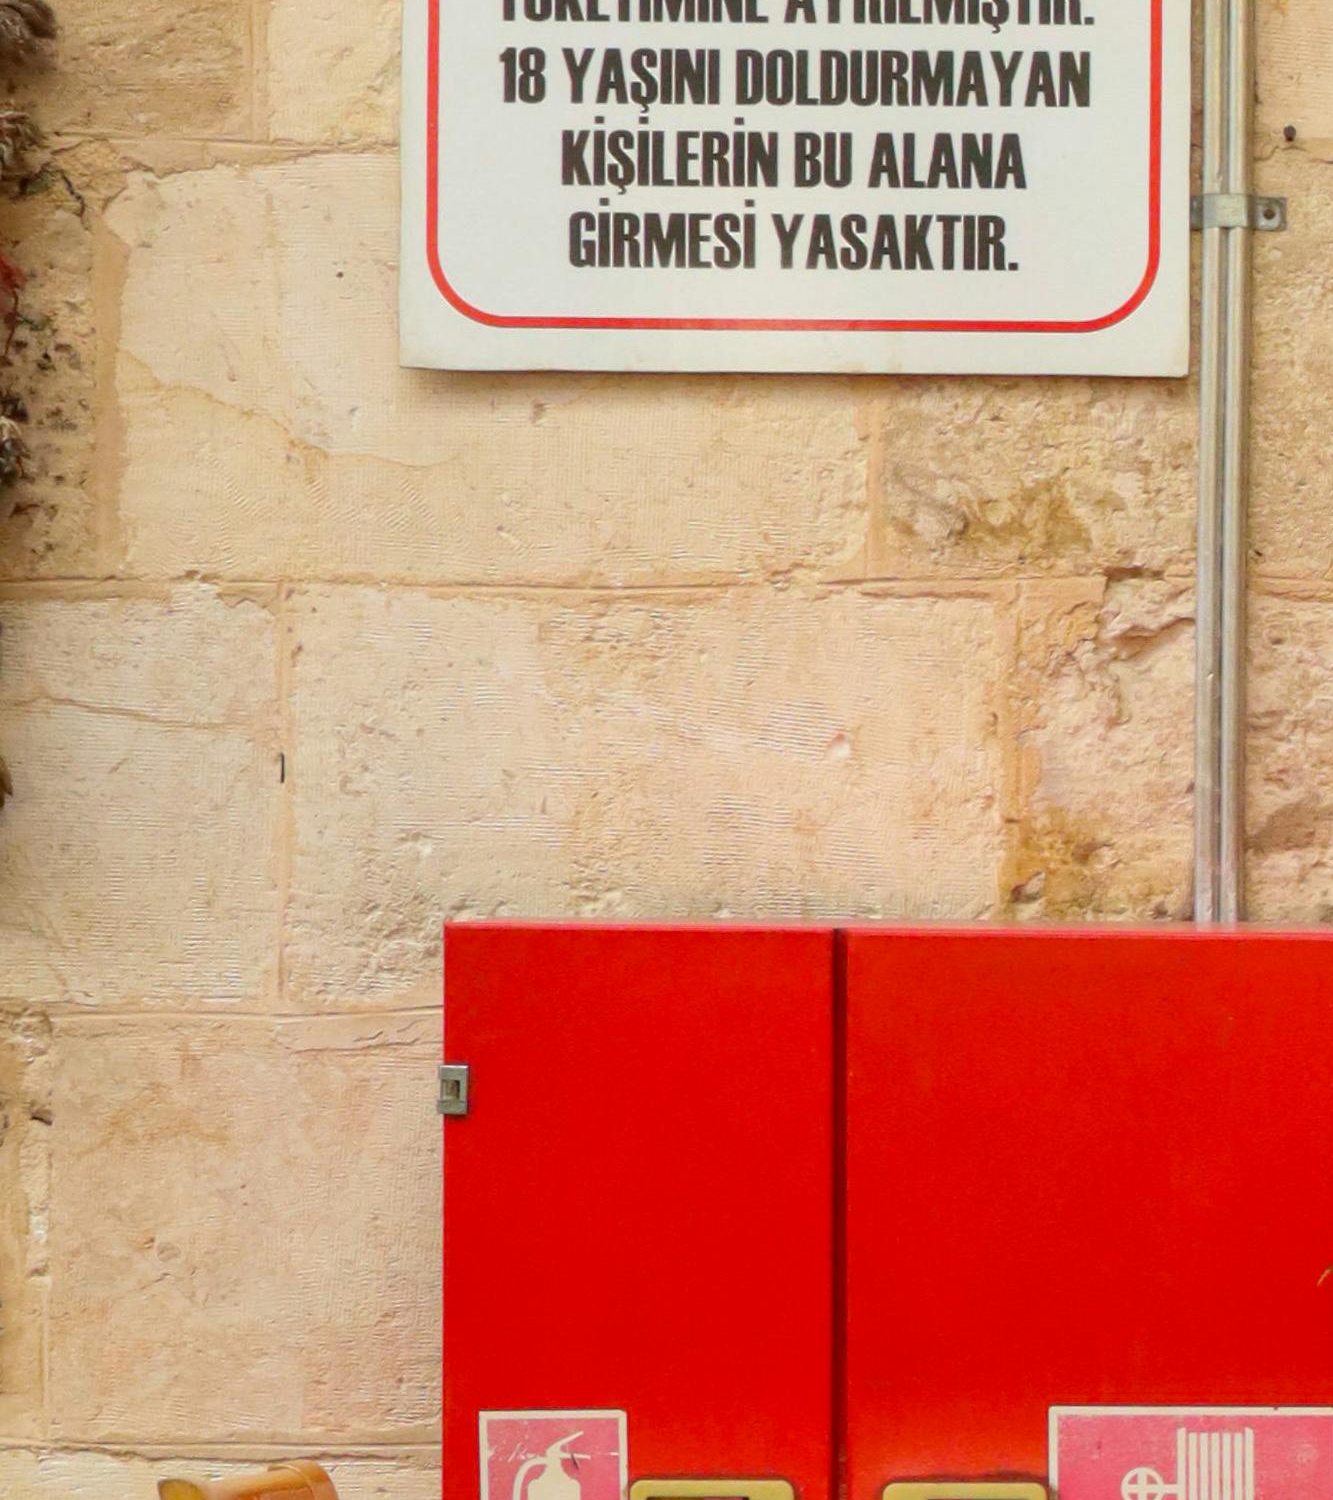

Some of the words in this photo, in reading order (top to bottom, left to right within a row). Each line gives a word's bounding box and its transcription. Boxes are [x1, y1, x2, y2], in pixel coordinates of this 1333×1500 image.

[500, 47, 546, 104] 18
[562, 48, 720, 114] YAŞINI
[736, 49, 1090, 107] DOLDURMAYAN
[562, 116, 778, 195] KİŞİLERİN
[794, 132, 852, 188] BU
[868, 132, 1027, 189] ALANA
[569, 197, 756, 268] GİRMESİ
[772, 214, 1018, 271] YASAKTIR.
